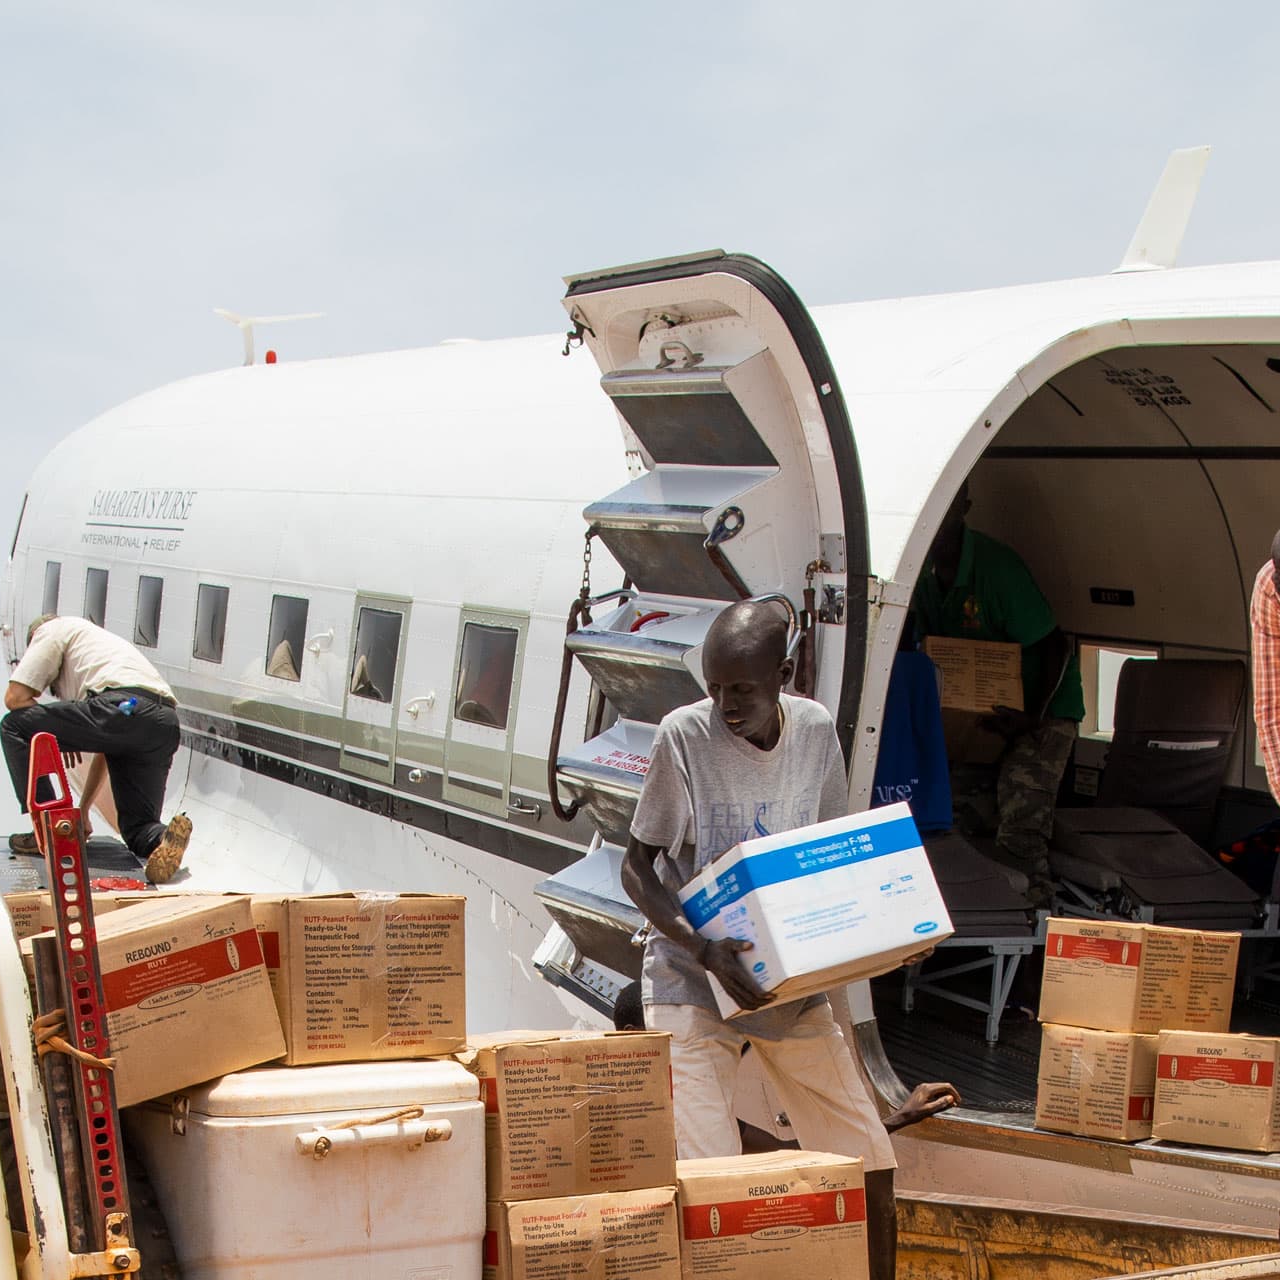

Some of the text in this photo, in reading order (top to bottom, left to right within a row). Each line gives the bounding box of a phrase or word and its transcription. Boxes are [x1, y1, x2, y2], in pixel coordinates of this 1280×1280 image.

[1159, 395, 1192, 406] KGS
[155, 491, 198, 521] PURSE
[80, 533, 183, 552] INTERNATIONAL RELIEF
[849, 833, 871, 846] F-100
[852, 843, 874, 856] F-100
[304, 914, 371, 923] RUTF-Peanut Formula
[304, 924, 348, 933] Ready-to-Use
[304, 932, 360, 941] Therapeutic Food
[125, 941, 172, 963] REBOUND
[305, 944, 340, 952] Instructions
[147, 958, 168, 970] RUTF
[305, 968, 342, 976] Instructions
[306, 989, 336, 997] Contains:
[1196, 1048, 1223, 1056] REBOUND
[503, 1055, 572, 1067] RUTF-Peanut Formula
[586, 1062, 609, 1070] Aliment
[504, 1067, 548, 1076] Ready-to-Use
[505, 1076, 544, 1084] Therapeutic
[505, 1086, 542, 1095] Instructions
[506, 1109, 543, 1118] Instructions
[508, 1131, 538, 1139] Contains:
[748, 1183, 789, 1197] REBOUND
[765, 1198, 784, 1206] RUTF
[522, 1211, 587, 1224] RUTF-Peanut Formula
[524, 1228, 577, 1240] Therapeutic Food
[603, 1234, 633, 1242] Conditions
[525, 1241, 560, 1251] Instructions
[560, 1240, 569, 1248] for
[526, 1264, 560, 1273] Instructions
